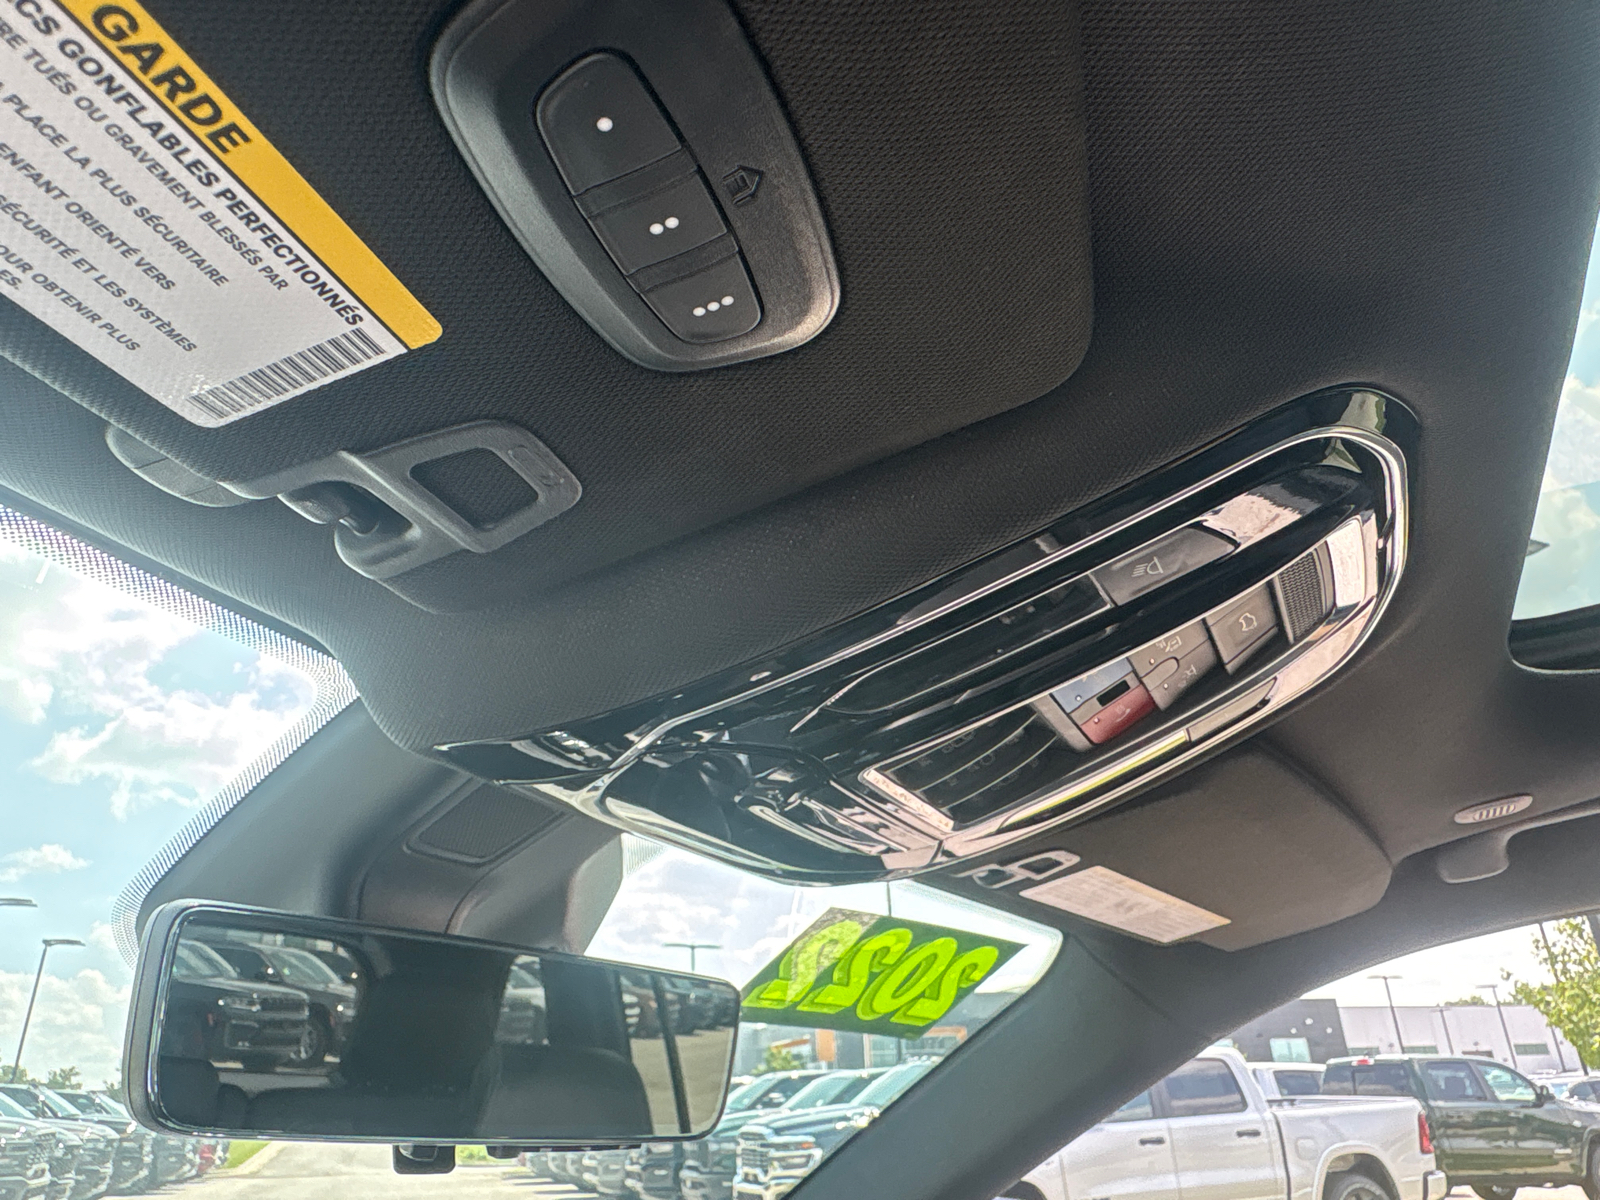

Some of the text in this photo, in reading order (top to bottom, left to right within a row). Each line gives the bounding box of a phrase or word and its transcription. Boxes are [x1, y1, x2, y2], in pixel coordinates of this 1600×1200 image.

[91, 4, 253, 154] GARDE
[0, 143, 176, 290] ENFANT ORIENTÉ VERS
[3, 93, 230, 287] PLACE LA PLUS SÉCURITAIRE
[9, 0, 364, 326] CS GONFLABLES PERFECTIONNÉS
[23, 47, 78, 95] TUÉS
[74, 96, 109, 122] OU
[104, 123, 206, 210] GRAVEMENT
[198, 210, 263, 267] BLESSÉS
[258, 265, 289, 291] PAR
[31, 272, 103, 324] OBTENIR
[98, 322, 141, 351] PLUS
[71, 257, 100, 274] ET
[92, 274, 127, 298] LES
[122, 297, 198, 352] SYSTÈMES
